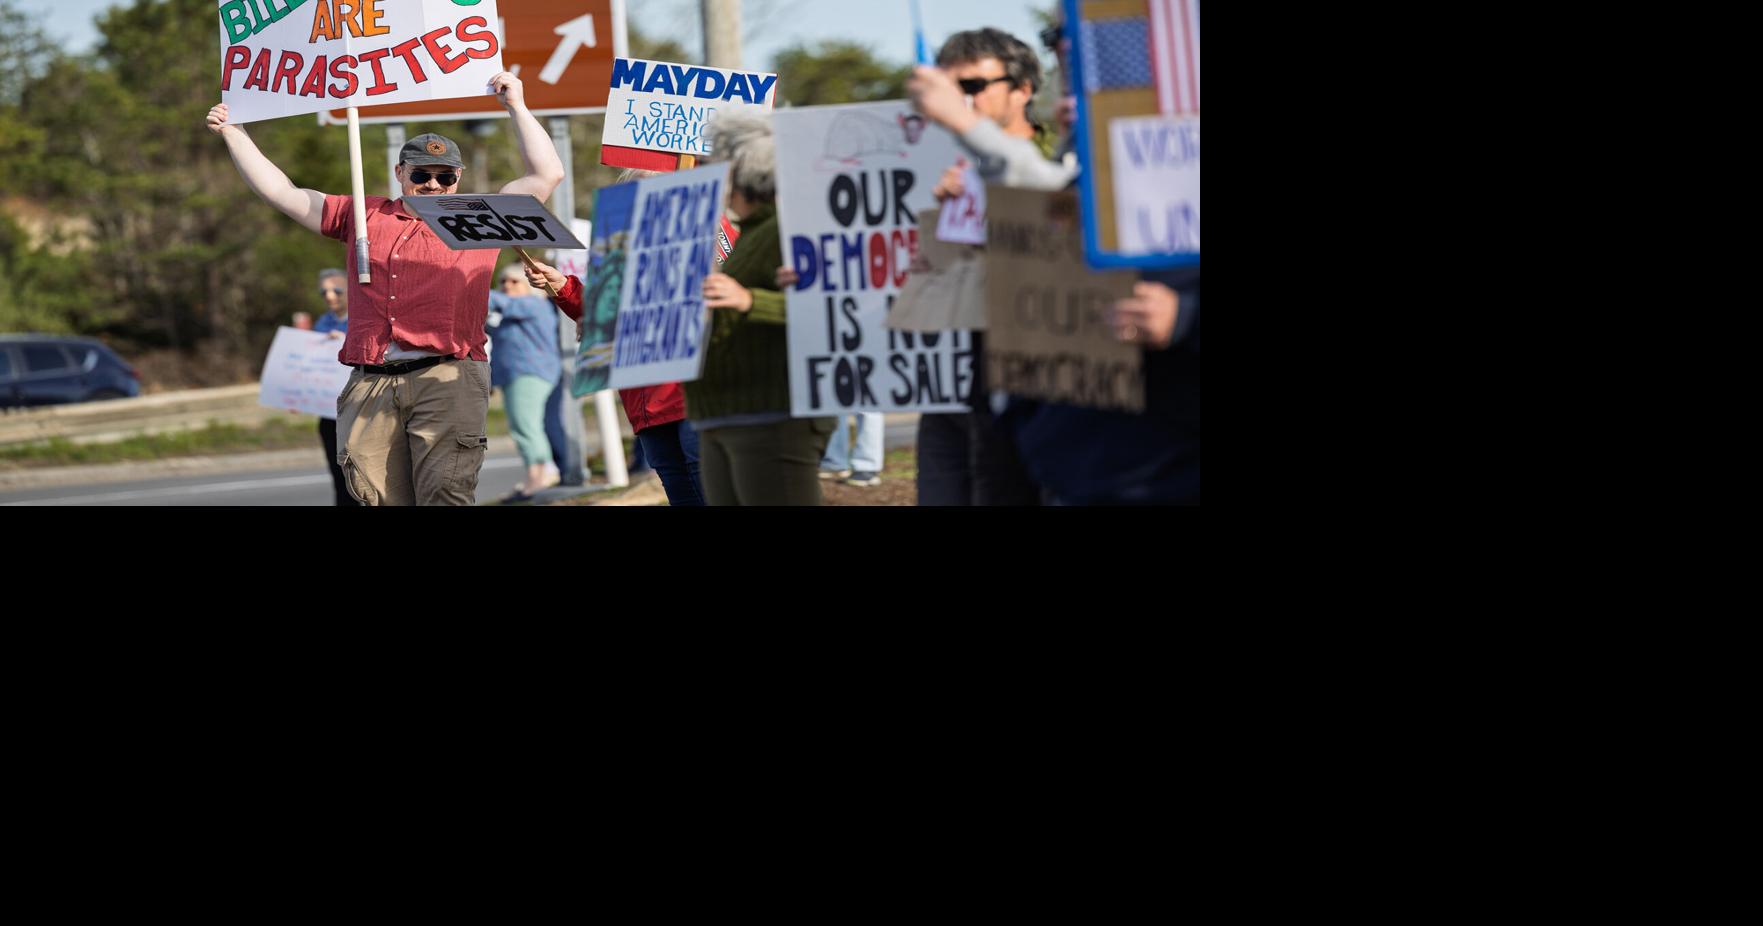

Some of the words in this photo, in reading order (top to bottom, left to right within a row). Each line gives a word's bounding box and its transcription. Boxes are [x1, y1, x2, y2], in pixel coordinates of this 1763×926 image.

[308, 0, 390, 43] ARE
[221, 15, 499, 99] PARASITES
[610, 58, 777, 104] MAYDAY
[623, 114, 713, 137] AMERIC
[624, 98, 636, 115] I
[632, 128, 713, 153] WORKE
[829, 169, 917, 228] OUR
[437, 213, 556, 242] RESIST
[790, 230, 918, 292] DEMOC
[825, 296, 862, 352] IS
[807, 355, 877, 410] FOR
[889, 351, 975, 407] SALE
